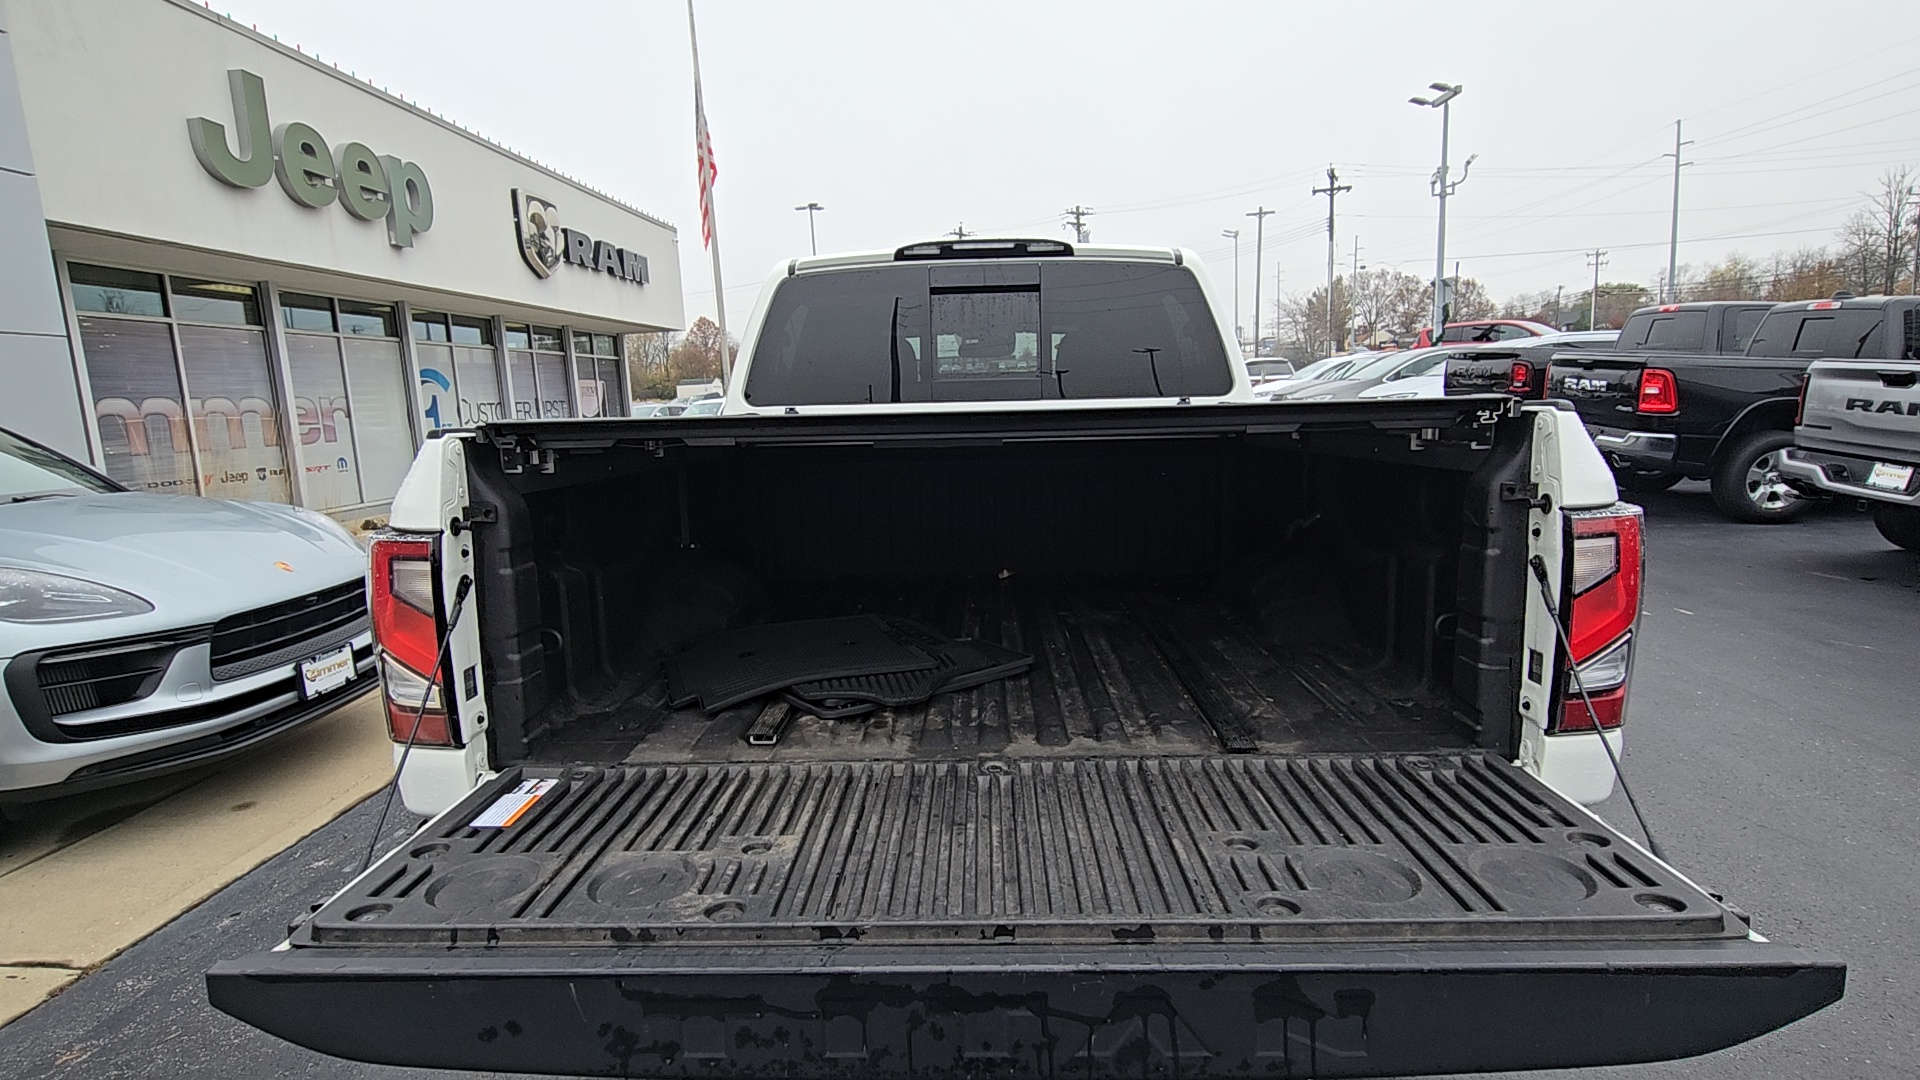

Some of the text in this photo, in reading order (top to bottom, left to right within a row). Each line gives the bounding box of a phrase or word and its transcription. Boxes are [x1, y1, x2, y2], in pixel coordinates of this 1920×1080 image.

[187, 68, 434, 249] Jeep
[563, 227, 650, 286] RAM
[1564, 377, 1608, 392] RAM
[458, 398, 533, 425] CUSTOER
[220, 470, 249, 485] Jeep
[269, 468, 286, 477] RA
